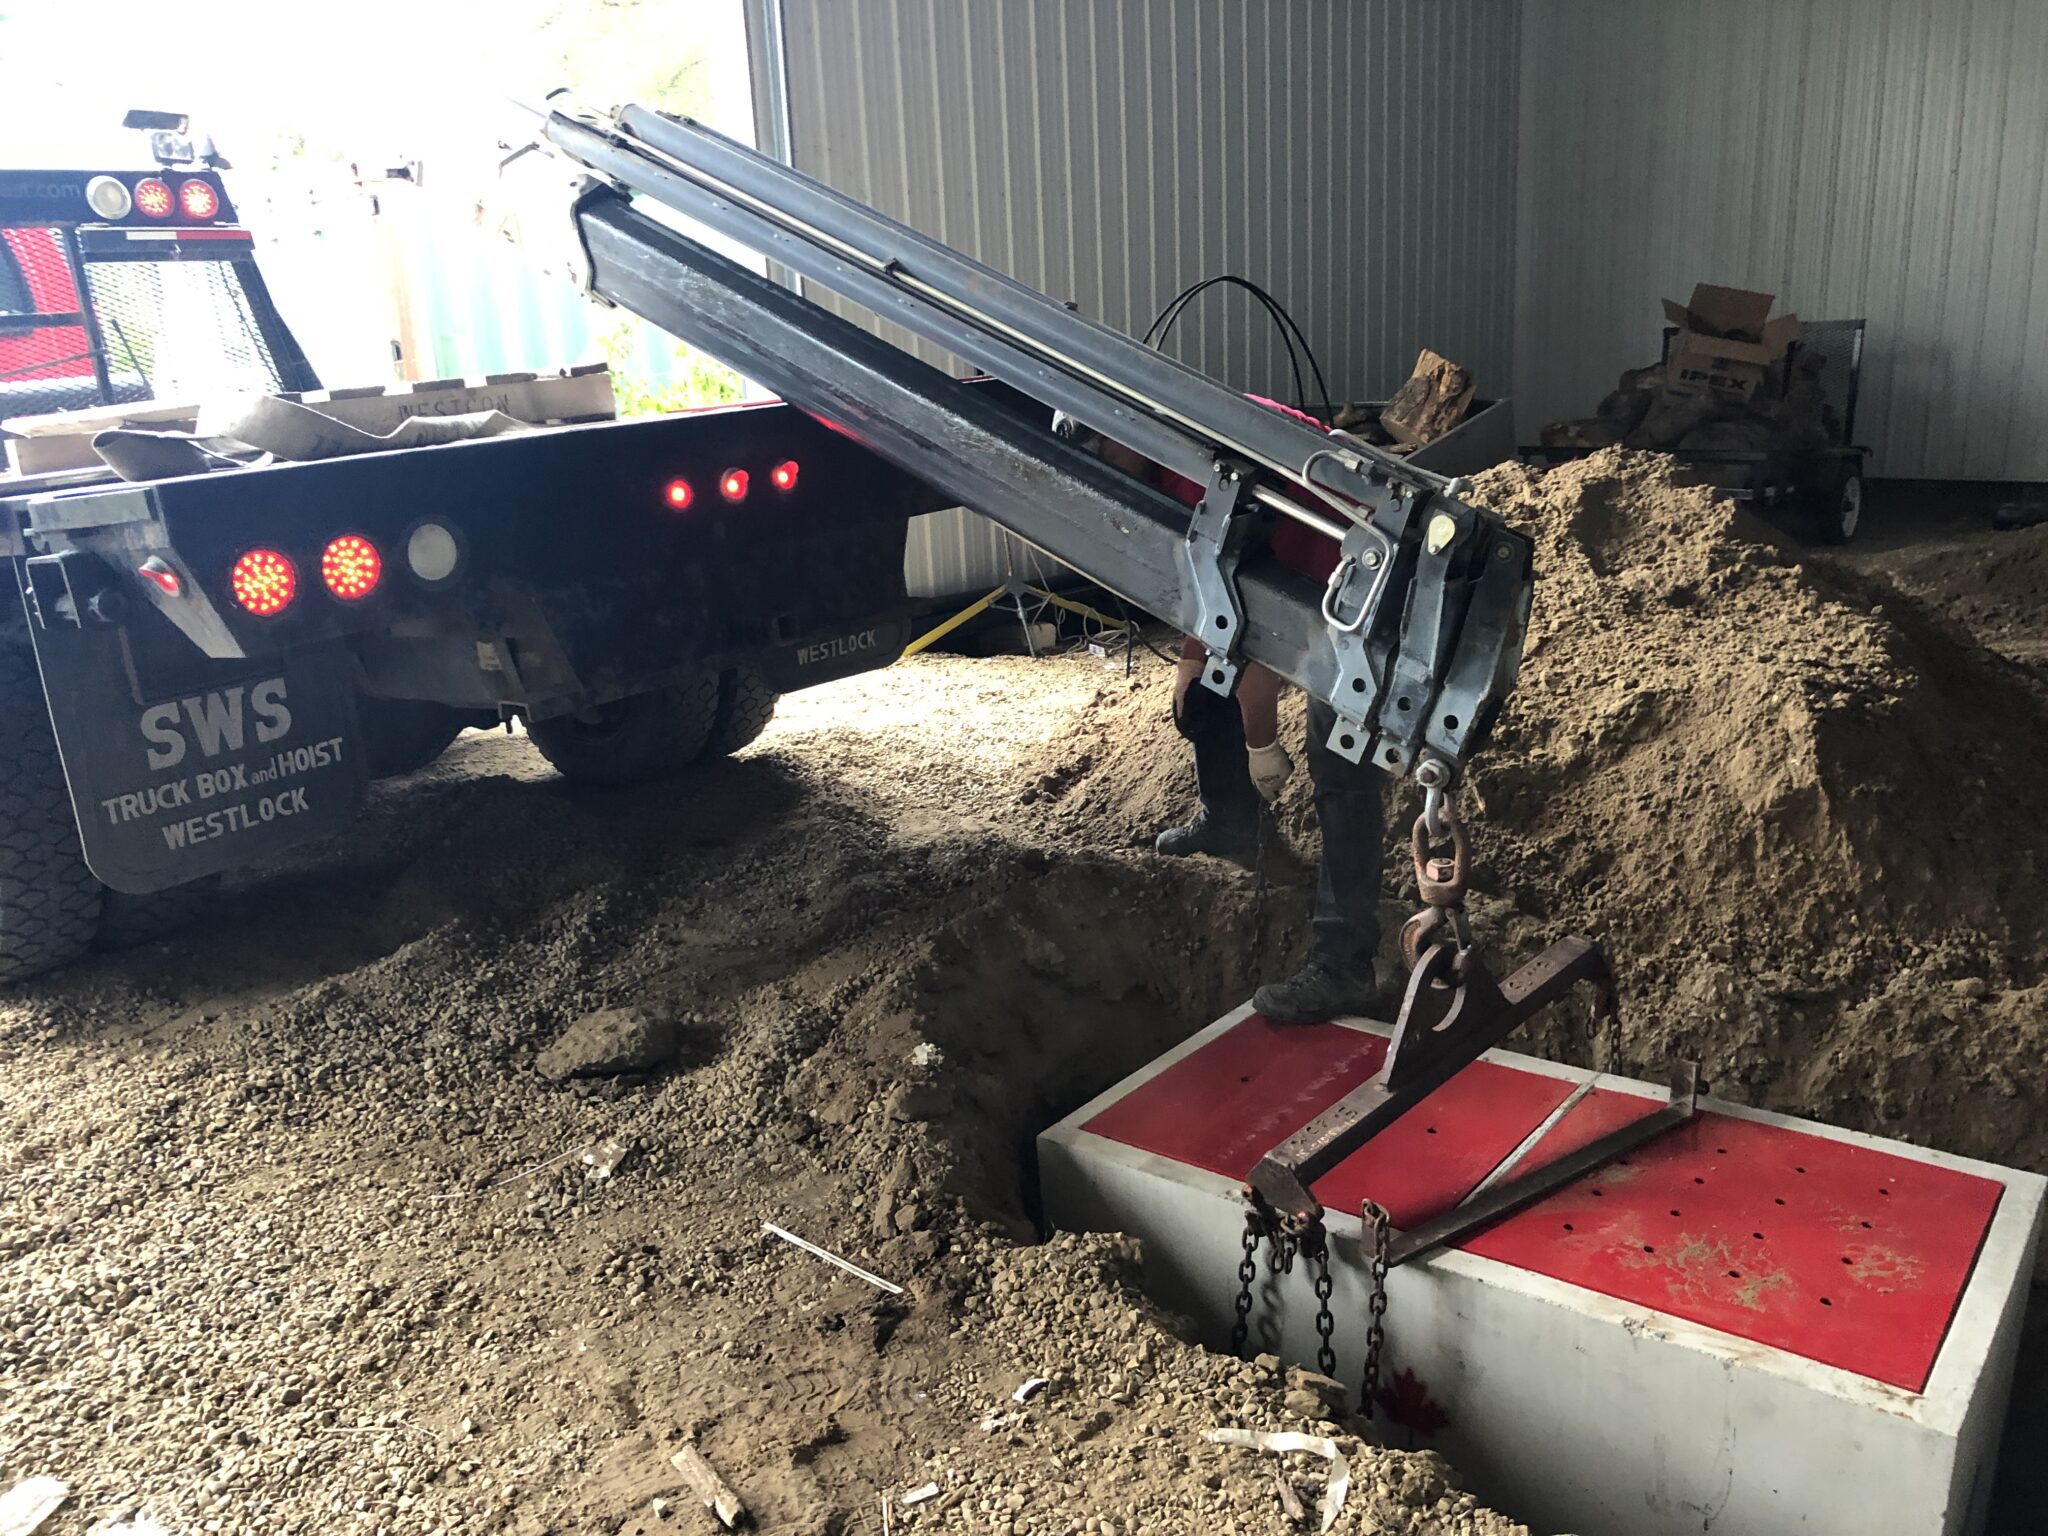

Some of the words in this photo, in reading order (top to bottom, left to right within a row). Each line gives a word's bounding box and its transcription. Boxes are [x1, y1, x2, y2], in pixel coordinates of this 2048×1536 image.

[1680, 368, 1747, 391] IPEX
[797, 629, 877, 666] WESTLOCK
[140, 677, 292, 771] SWS
[101, 779, 192, 824] TRUCK
[196, 763, 249, 799] BOX
[251, 757, 278, 785] and
[278, 737, 344, 777] HOIST
[162, 787, 310, 850] WESTLOCK
